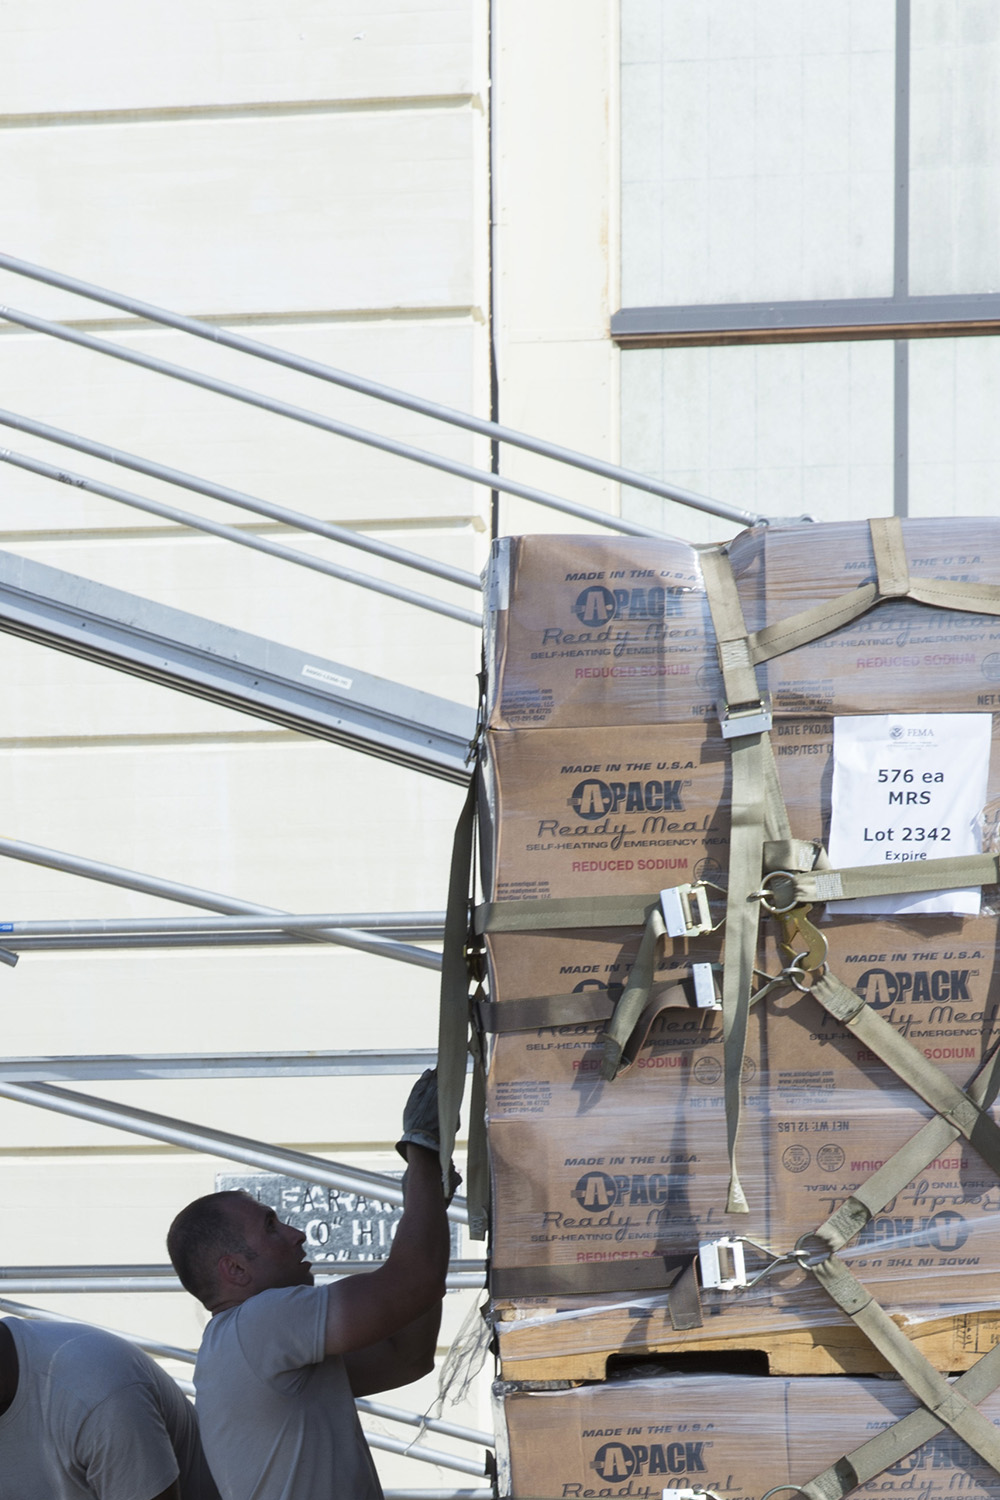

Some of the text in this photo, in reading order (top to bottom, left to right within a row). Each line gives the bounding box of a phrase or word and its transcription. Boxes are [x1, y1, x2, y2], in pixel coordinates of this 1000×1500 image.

[565, 570, 656, 581] MADE IN THE
[531, 649, 611, 660] SELF-HEATING
[856, 654, 976, 668] REDUCED SODIUM
[575, 665, 690, 678] REDUCED SODIUM
[778, 726, 800, 736] DATE
[561, 765, 602, 774] MADE
[627, 763, 651, 771] THE
[878, 769, 944, 783] 576 ea
[888, 791, 931, 805] MRS
[537, 816, 720, 850] Ready Meal
[864, 828, 951, 841] Lot 2342
[526, 839, 698, 851] SELF-HEATING EMERGENCY
[885, 851, 927, 861] Expire
[572, 858, 688, 872] REDUCED SODIUM
[845, 951, 985, 963] MADE IN THE U.S.A.
[560, 964, 620, 974] MADE IN
[910, 1029, 984, 1037] EMERGENCY
[924, 1048, 975, 1058] SODIUM
[638, 1057, 688, 1068] SODIUM
[565, 1157, 605, 1166] MADE
[609, 1156, 625, 1165] IN
[630, 1156, 655, 1164] THE
[542, 1210, 640, 1243] Ready
[531, 1233, 613, 1241] SELF-HEATING
[582, 1428, 621, 1437] MADE
[627, 1427, 642, 1435] IN
[648, 1426, 673, 1434] THE
